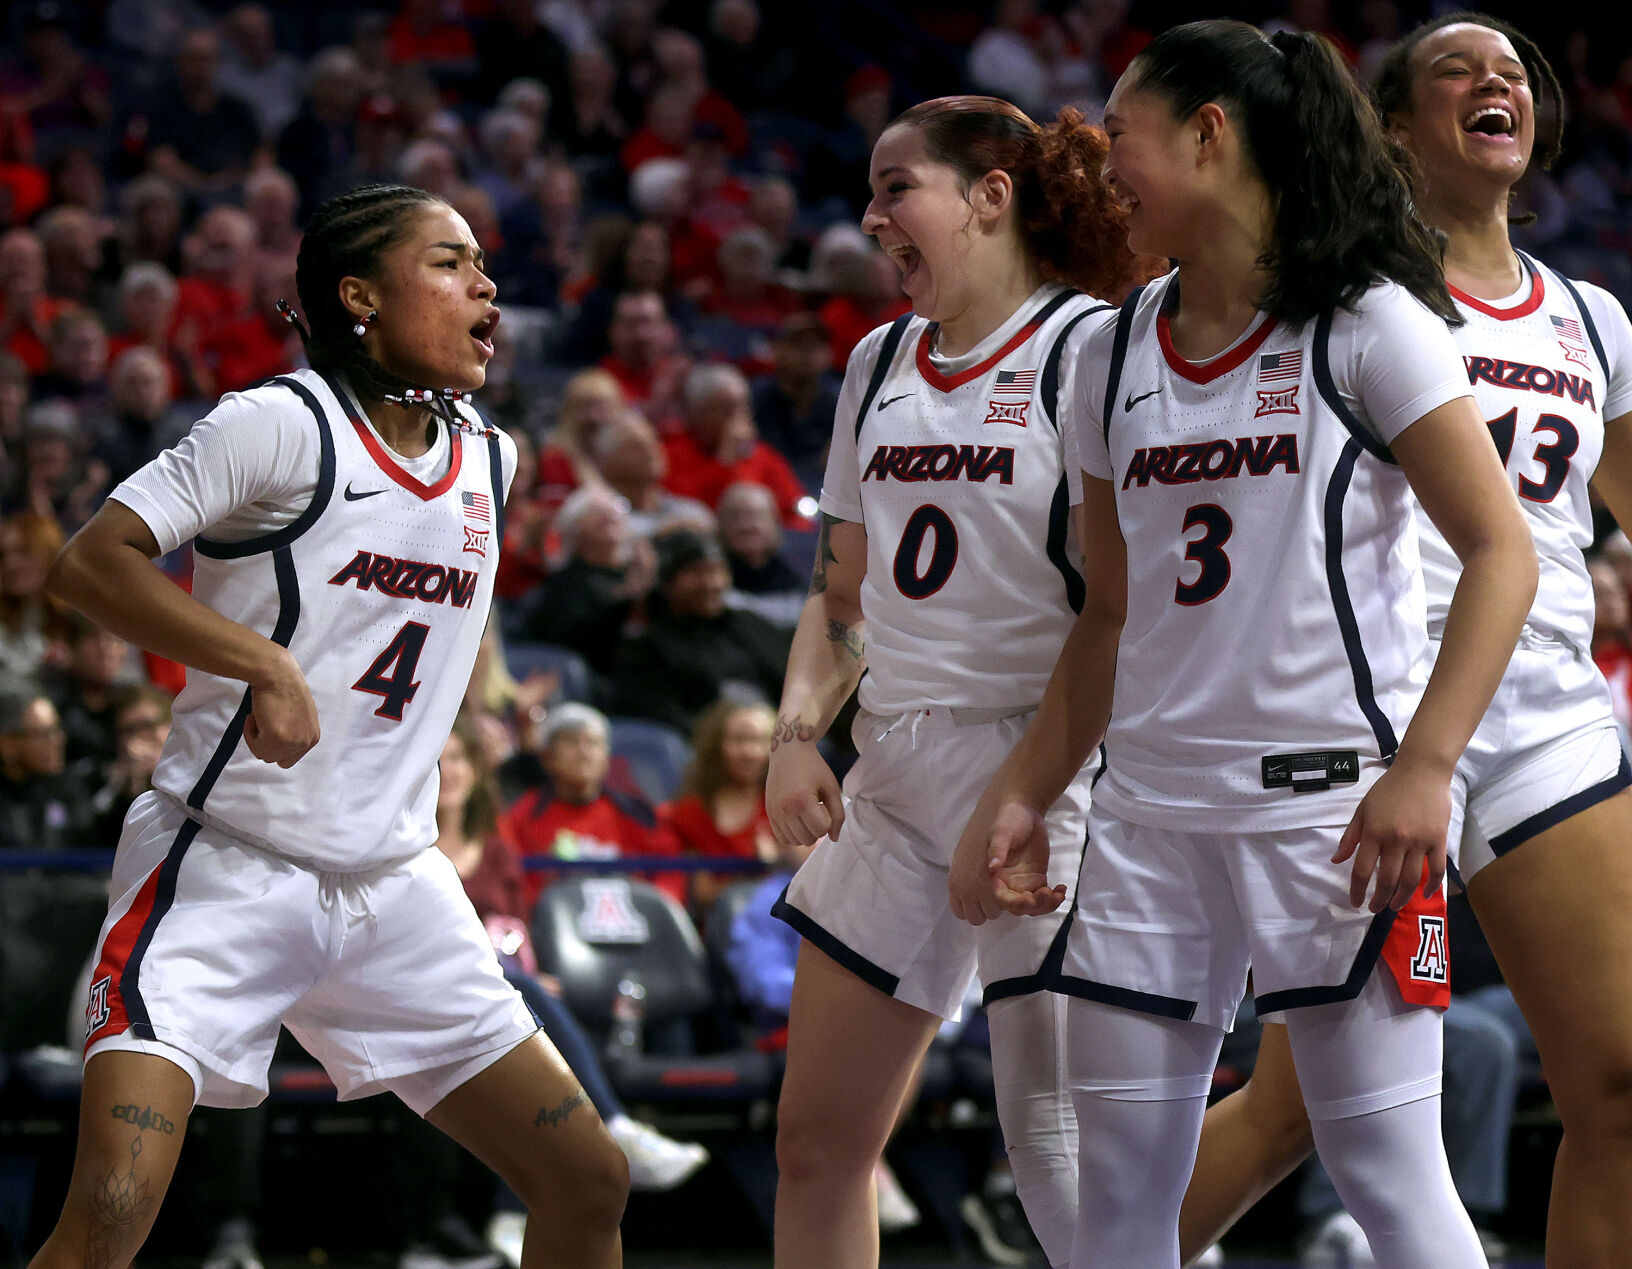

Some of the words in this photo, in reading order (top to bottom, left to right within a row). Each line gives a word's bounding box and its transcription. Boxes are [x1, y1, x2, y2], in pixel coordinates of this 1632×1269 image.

[1462, 355, 1597, 414] RIZONA
[861, 443, 1015, 485] ARIZONA
[1121, 433, 1300, 491] ARIZONA
[327, 549, 479, 610] ARIZONA
[893, 503, 959, 601] 0
[1174, 503, 1233, 606] 3
[351, 620, 431, 722] 4
[1333, 760, 1350, 772] 44
[1410, 914, 1448, 984] A
